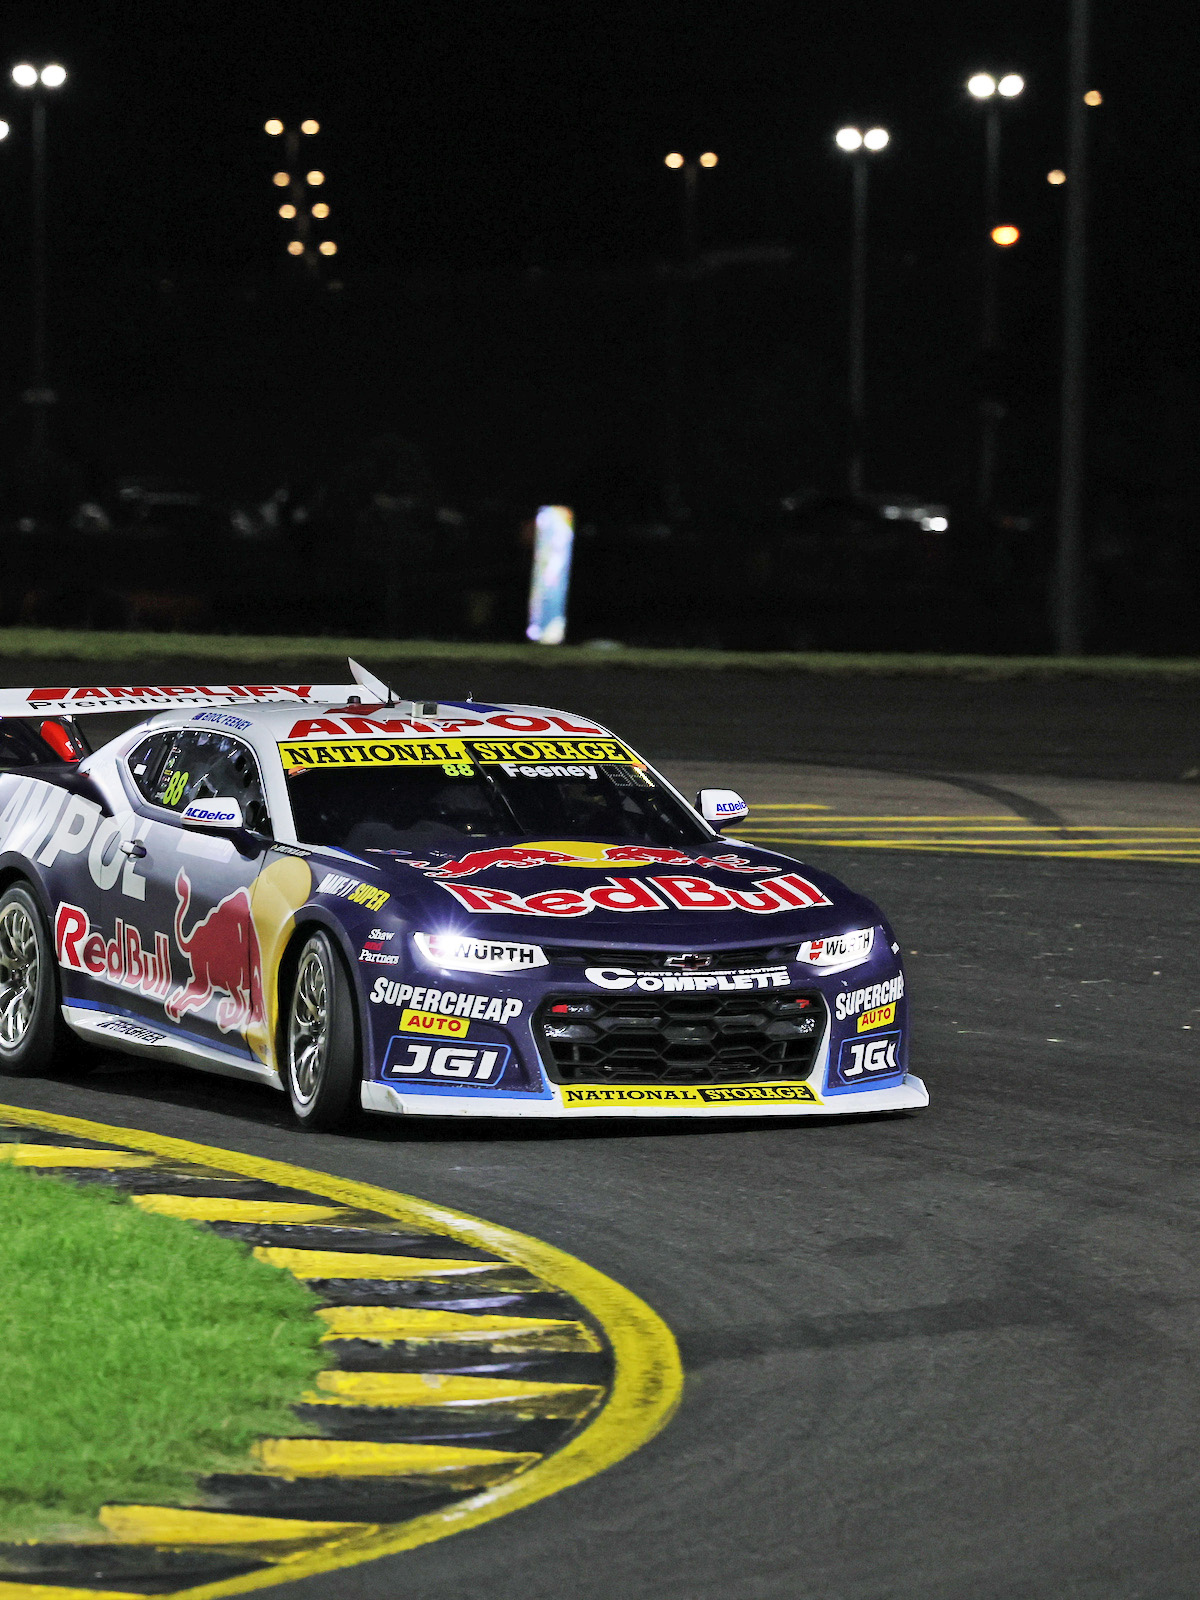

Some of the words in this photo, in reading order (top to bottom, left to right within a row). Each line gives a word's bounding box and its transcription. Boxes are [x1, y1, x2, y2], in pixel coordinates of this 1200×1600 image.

[71, 685, 312, 700] AMPLIFY
[28, 697, 212, 710] Premium
[288, 714, 603, 738] AMPOL
[284, 743, 463, 765] NATIONAL
[473, 741, 626, 761] STORAGE
[442, 764, 475, 777] 88
[499, 763, 599, 780] Feeney
[162, 770, 189, 806] 88
[185, 807, 236, 821] ACDelco
[347, 882, 391, 912] SUPER
[368, 928, 395, 941] Shaw
[358, 948, 400, 965] Partners
[584, 967, 791, 992] COMPLETE
[369, 976, 523, 1025] SUPERCHEAP
[407, 1015, 462, 1032] AUTO
[861, 1007, 891, 1027] AUTO
[391, 1044, 499, 1080] JGI
[843, 1039, 897, 1077] JGI
[566, 1088, 697, 1101] NATIONAL
[708, 1085, 811, 1100] STORAGE
